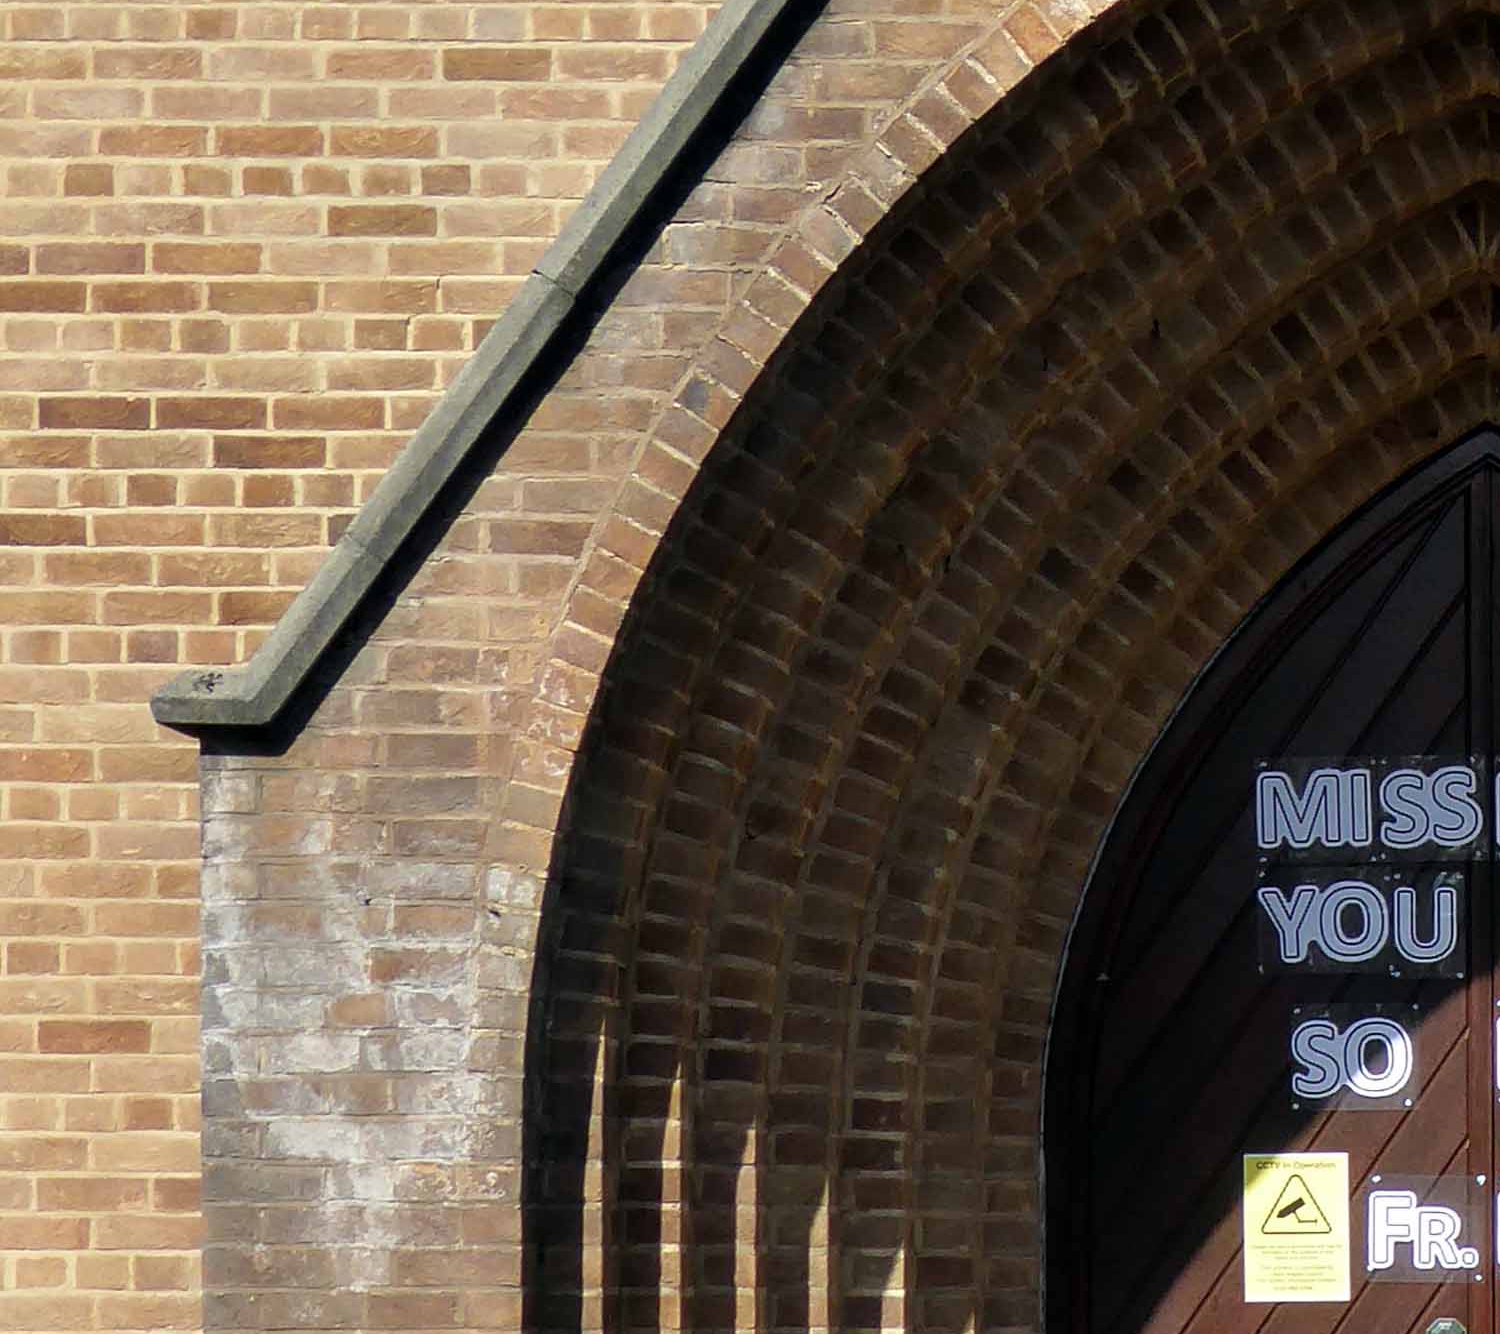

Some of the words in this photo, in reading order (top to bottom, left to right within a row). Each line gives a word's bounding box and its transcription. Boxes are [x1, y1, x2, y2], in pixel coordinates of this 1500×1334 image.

[1258, 881, 1458, 963] YOU
[1292, 1017, 1413, 1097] SO
[1256, 1161, 1281, 1170] CCTV
